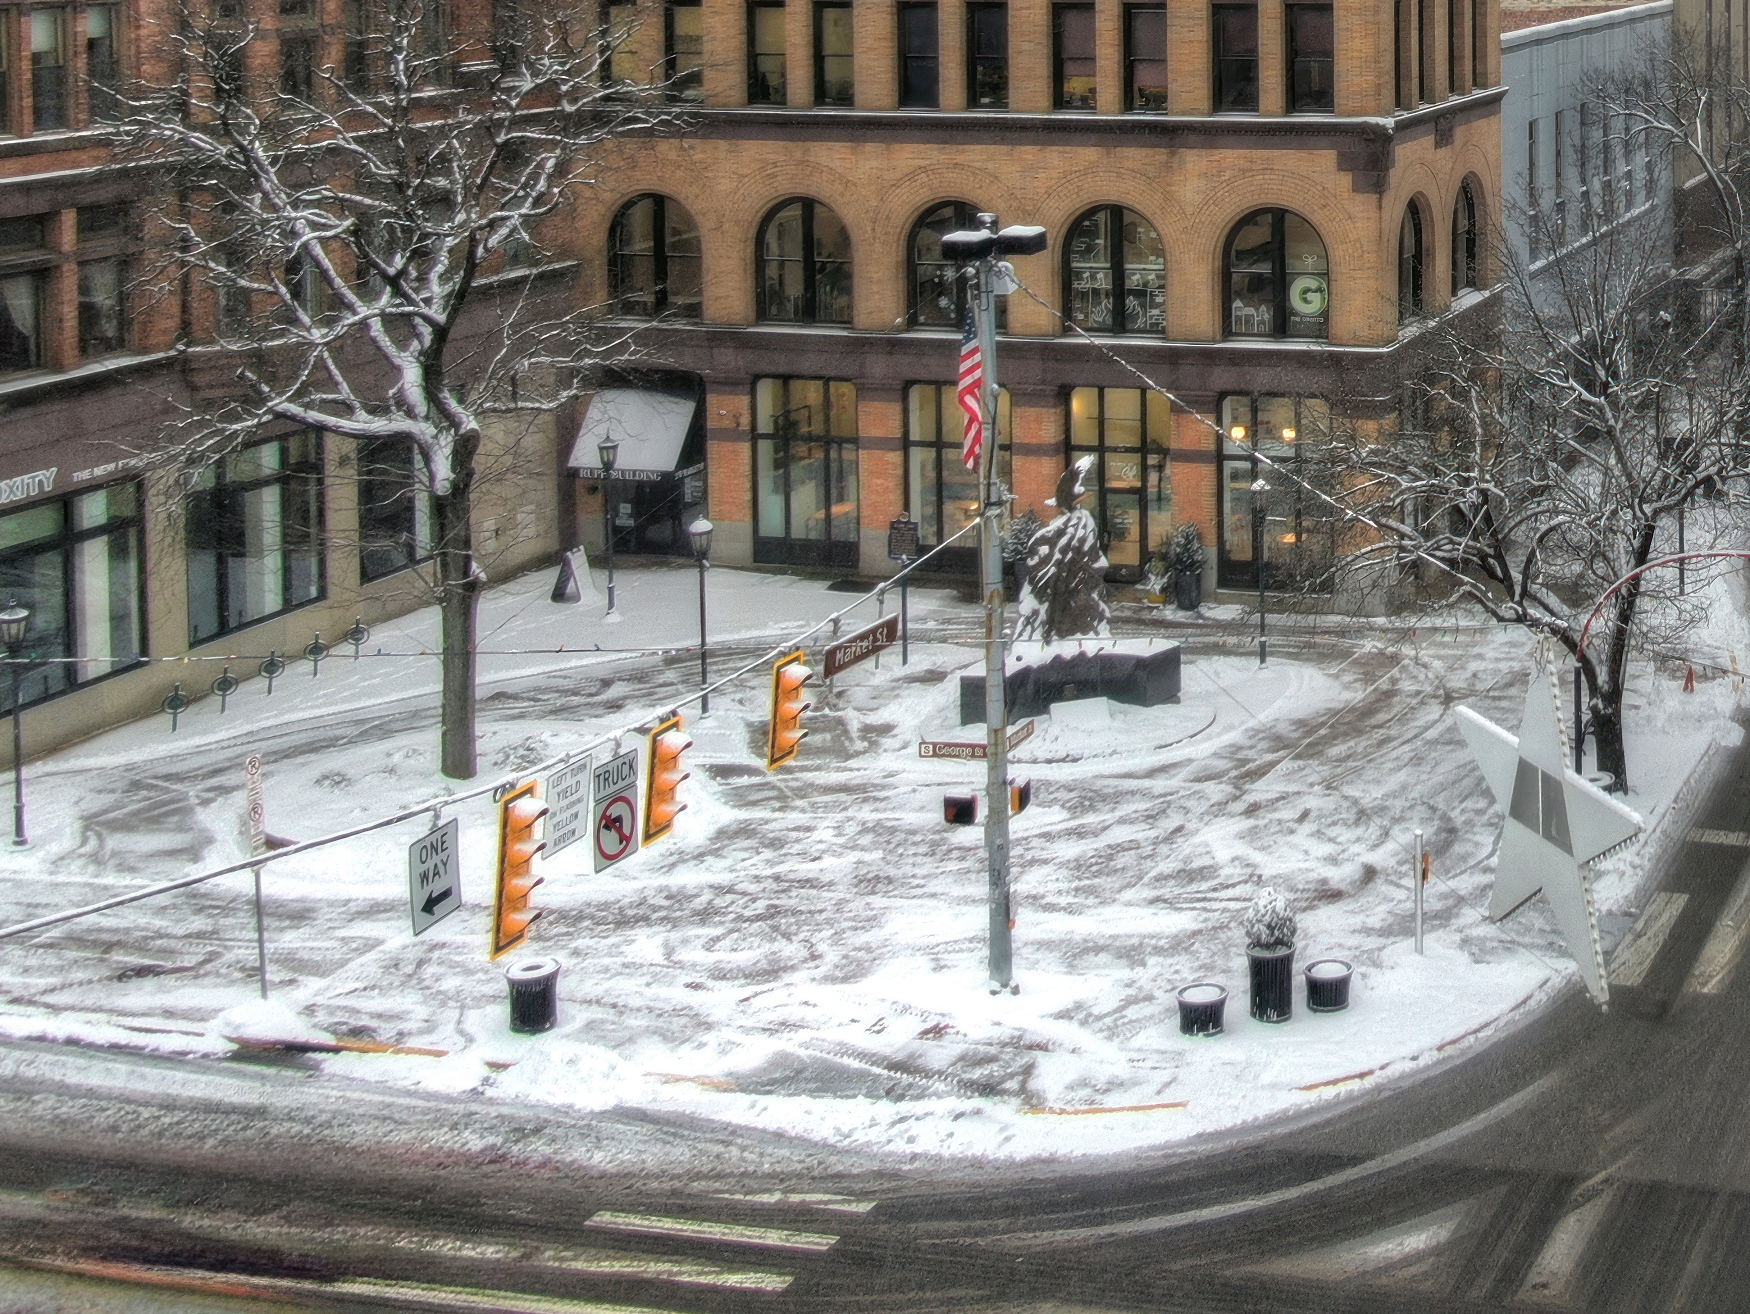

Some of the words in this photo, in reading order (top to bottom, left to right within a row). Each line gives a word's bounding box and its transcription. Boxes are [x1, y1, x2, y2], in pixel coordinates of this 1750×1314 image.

[0, 467, 57, 503] XITY
[835, 635, 873, 667] Market
[877, 624, 887, 644] St
[923, 745, 930, 754] S
[936, 744, 972, 757] George
[551, 772, 567, 789] LEFT
[556, 780, 581, 803] YIELD
[595, 758, 636, 794] TRUCK
[552, 809, 579, 834] YELLOW
[419, 831, 449, 865] ONE
[419, 855, 450, 890] WAY
